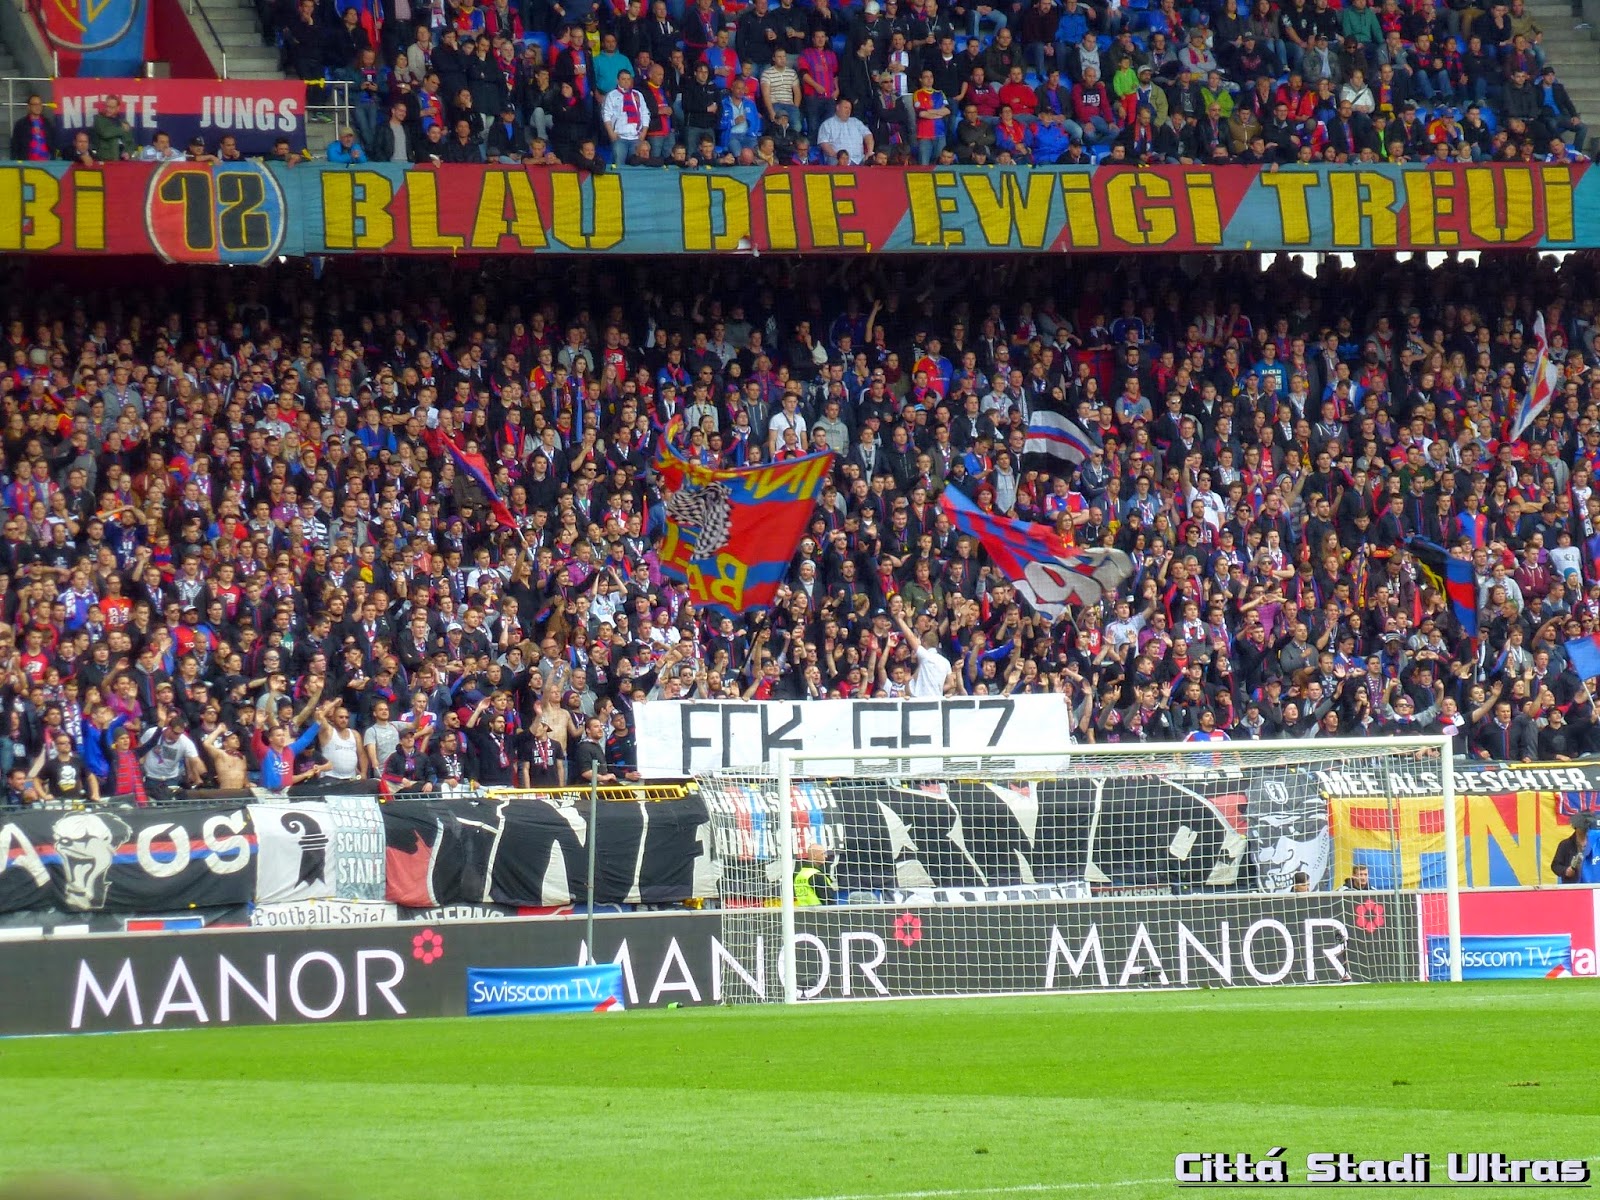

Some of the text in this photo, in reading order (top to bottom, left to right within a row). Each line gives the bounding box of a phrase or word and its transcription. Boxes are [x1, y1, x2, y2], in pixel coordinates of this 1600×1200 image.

[200, 96, 297, 132] JUNGS
[158, 170, 272, 252] 12
[321, 169, 625, 252] BLAU
[1316, 769, 1386, 796] MEE
[1390, 770, 1444, 796] ALS
[1045, 918, 1352, 988] MANOR
[71, 949, 407, 1029] MANOR
[473, 979, 570, 1004] Swisscom
